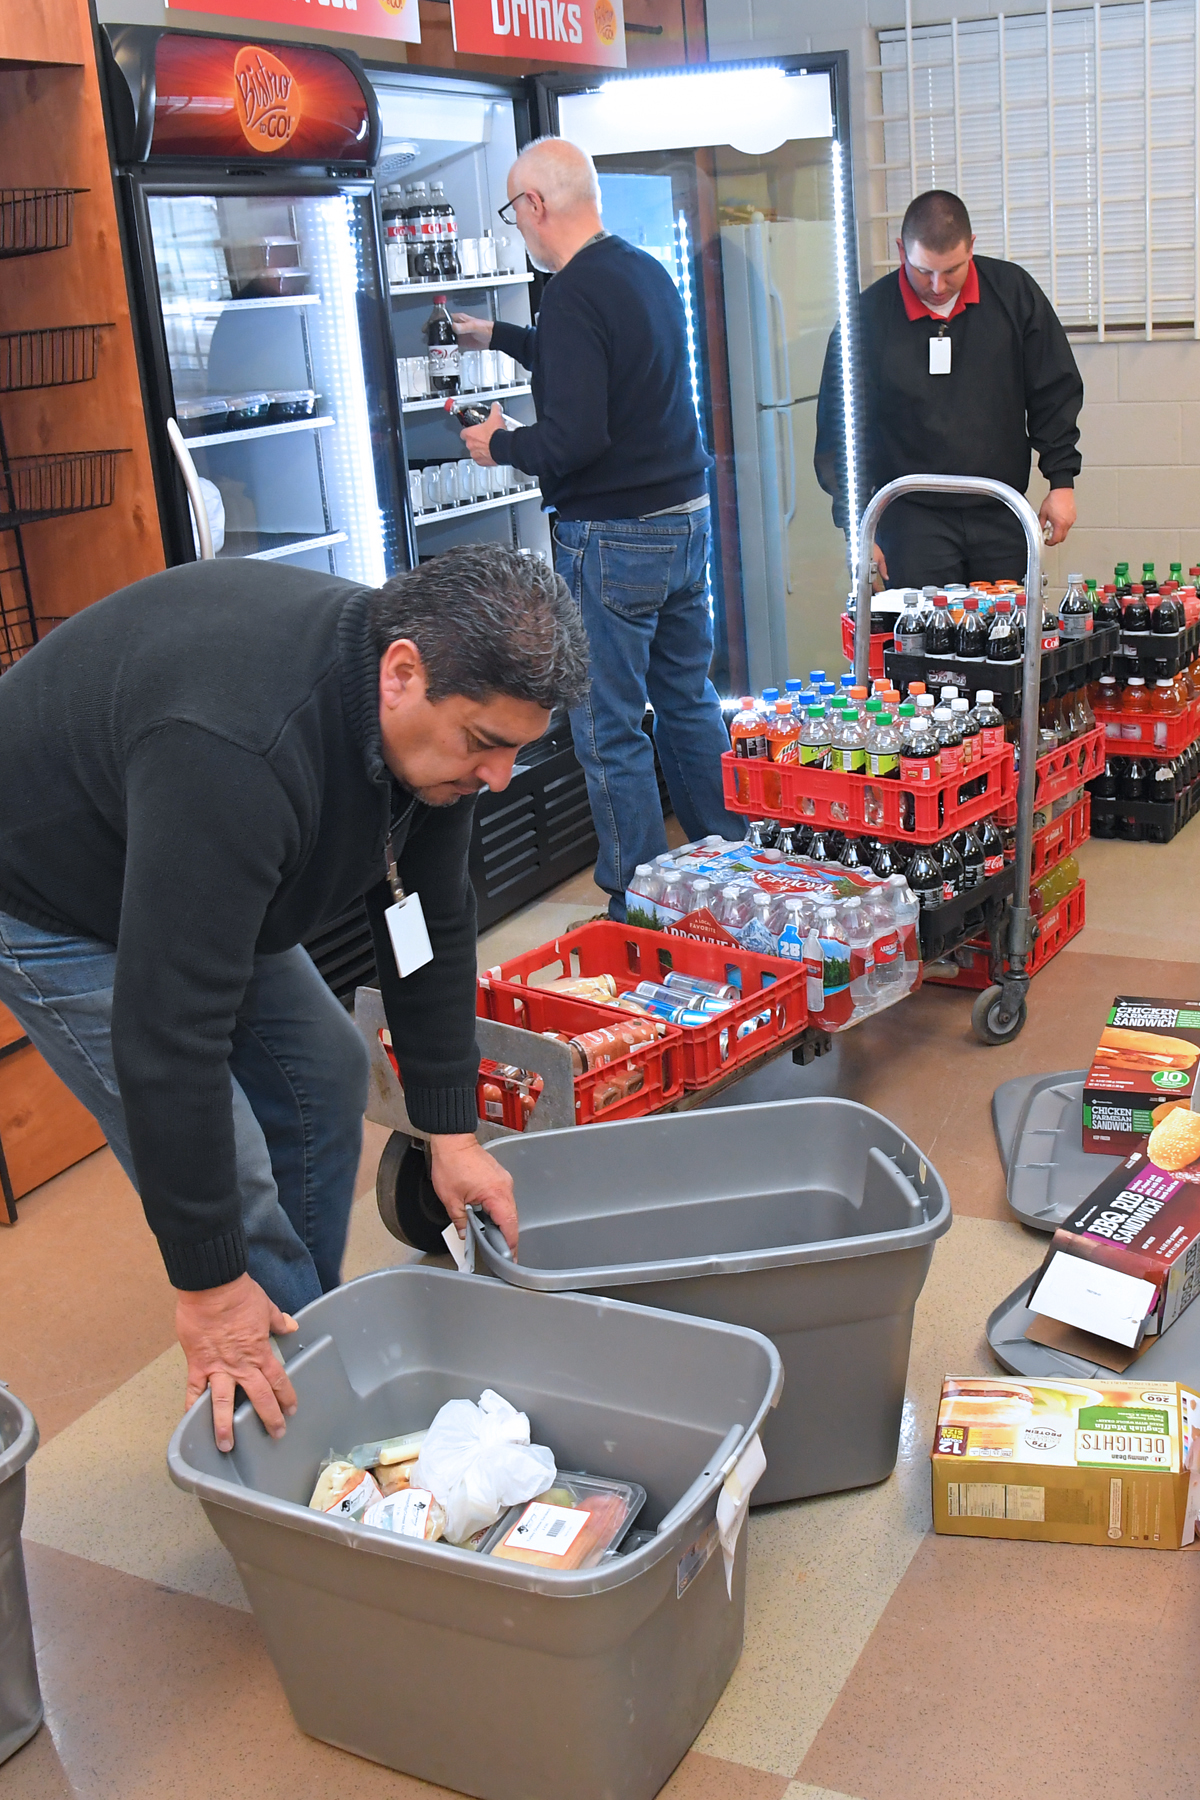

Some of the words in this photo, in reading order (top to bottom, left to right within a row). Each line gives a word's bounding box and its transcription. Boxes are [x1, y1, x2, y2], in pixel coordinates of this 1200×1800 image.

[491, 0, 583, 44] Drinks
[236, 54, 292, 127] Bistro
[267, 114, 291, 139] GO!
[689, 923, 717, 934] FAVORITE
[780, 940, 801, 957] 28
[1114, 1012, 1178, 1021] PARMESAN
[1116, 1006, 1180, 1017] CHICKEN
[1112, 1017, 1177, 1029] SANDWICH
[1160, 1071, 1183, 1083] 10
[1091, 1106, 1133, 1117] CHICKEN
[1092, 1113, 1133, 1123] PARMESAN
[1092, 1120, 1133, 1132] SANDWICH
[1086, 1211, 1130, 1239] BBQ
[1109, 1190, 1146, 1214] RIB
[1112, 1197, 1165, 1245] SANDWICH
[1095, 1422, 1127, 1431] Muffin
[1129, 1424, 1165, 1434] English
[1025, 1429, 1062, 1438] PROTEIN
[939, 1440, 962, 1454] 12
[1032, 1440, 1047, 1448] 17g
[1081, 1433, 1165, 1454] DELIGHTS
[1128, 1453, 1149, 1461] Jimmy
